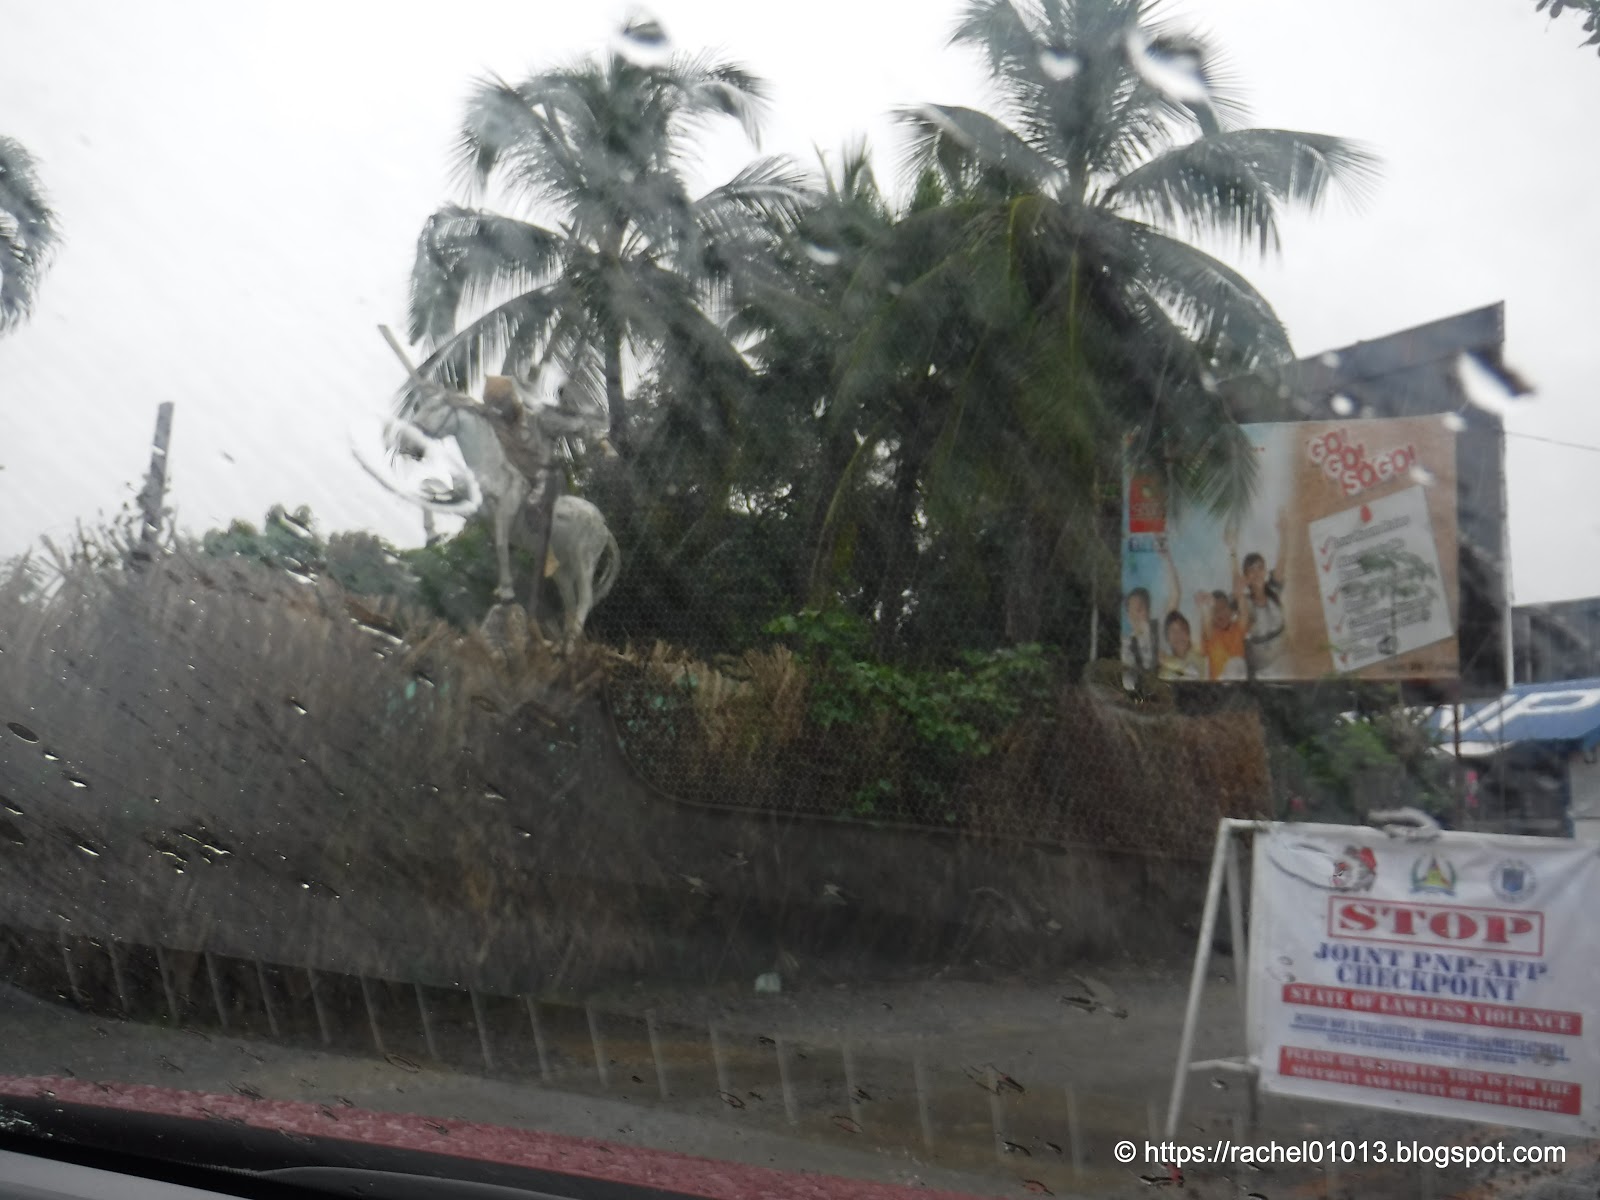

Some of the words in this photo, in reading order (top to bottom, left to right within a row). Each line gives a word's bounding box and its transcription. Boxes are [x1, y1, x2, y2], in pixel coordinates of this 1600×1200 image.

[1325, 443, 1365, 479] GO!
[1342, 444, 1416, 496] SOGO!
[1340, 903, 1533, 944] STOP
[1314, 942, 1404, 968] JOINT
[1412, 952, 1547, 981] PNP-AFP
[1336, 965, 1520, 1001] CHECKPOINT
[1290, 987, 1346, 1005] STATE
[1351, 993, 1374, 1009] OF
[1379, 996, 1466, 1018] LAWLESS
[1470, 1006, 1572, 1030] VIOLENCE
